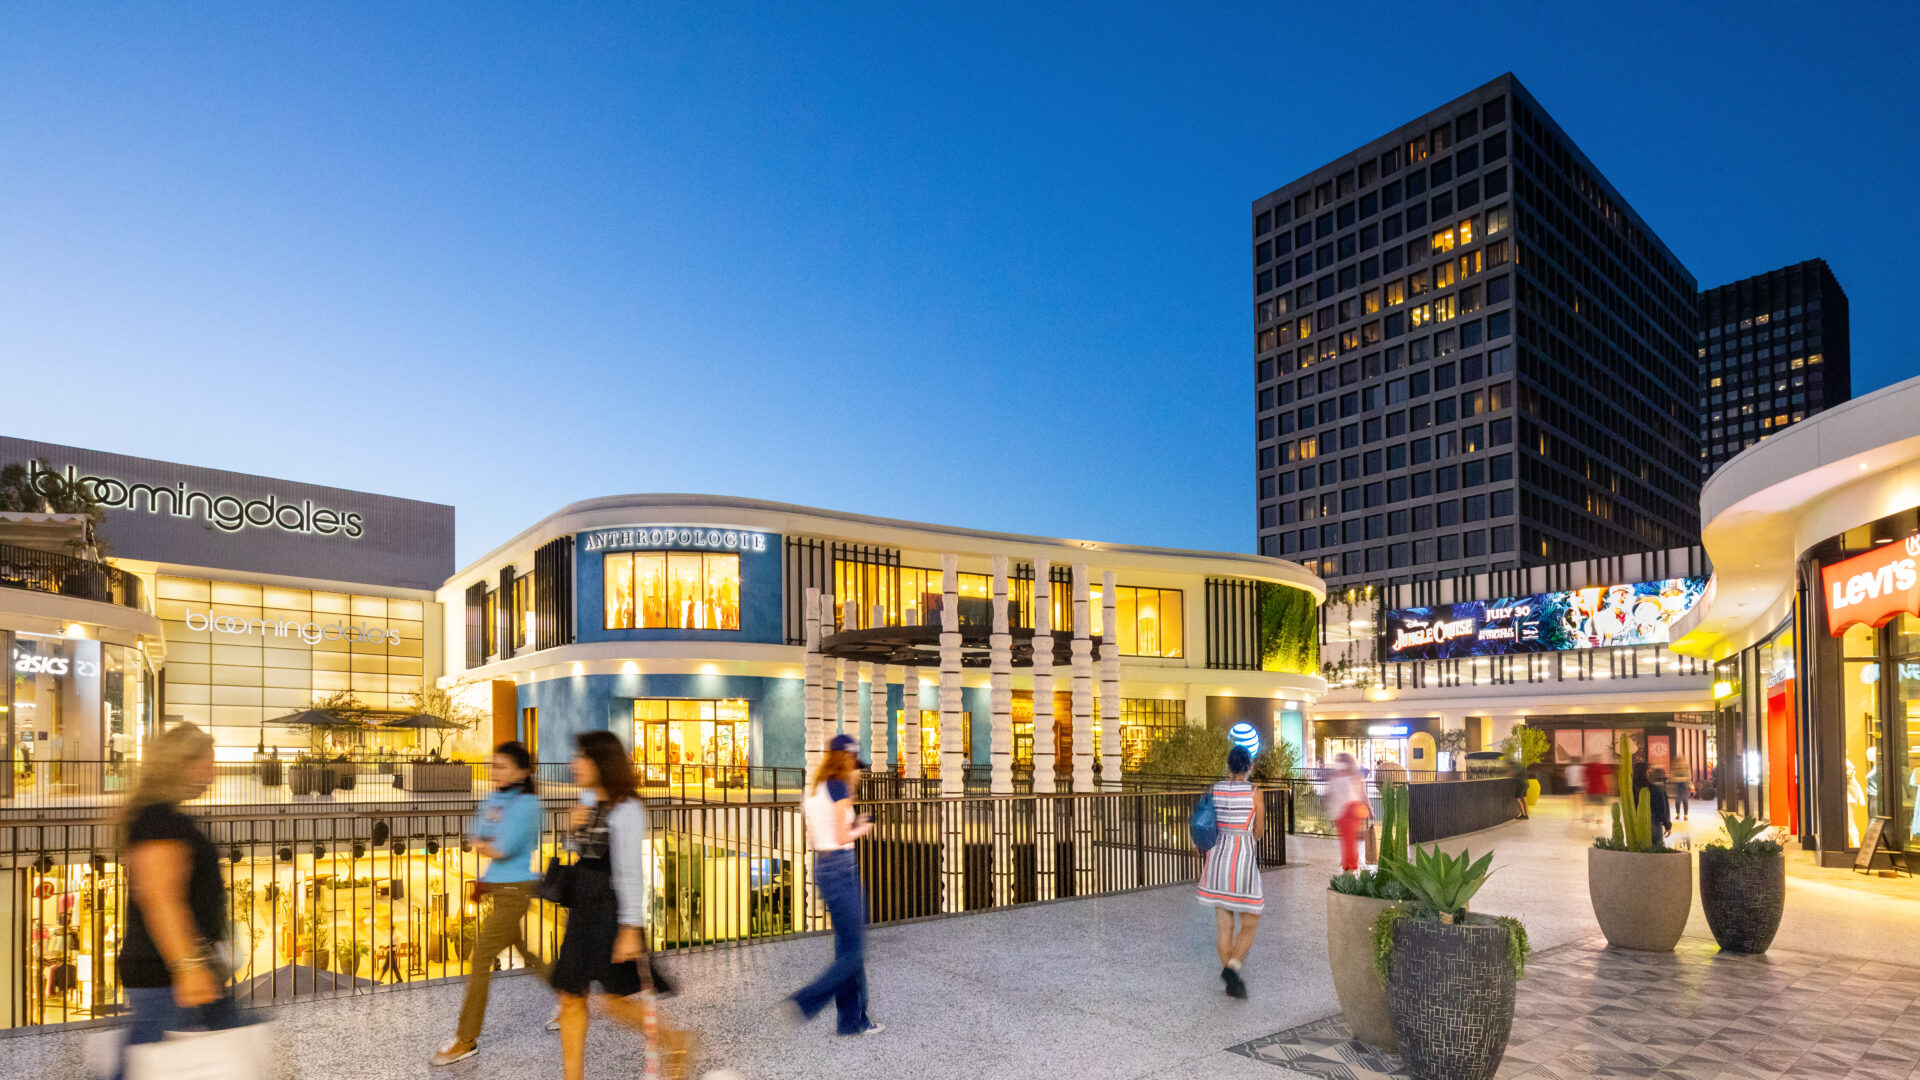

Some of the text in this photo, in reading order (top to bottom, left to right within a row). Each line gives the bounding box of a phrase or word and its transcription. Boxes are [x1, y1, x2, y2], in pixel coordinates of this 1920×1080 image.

[585, 530, 765, 550] ANTHROPOLOGIE
[1486, 605, 1531, 622] JULY 30
[186, 607, 401, 645] bloomingdale's
